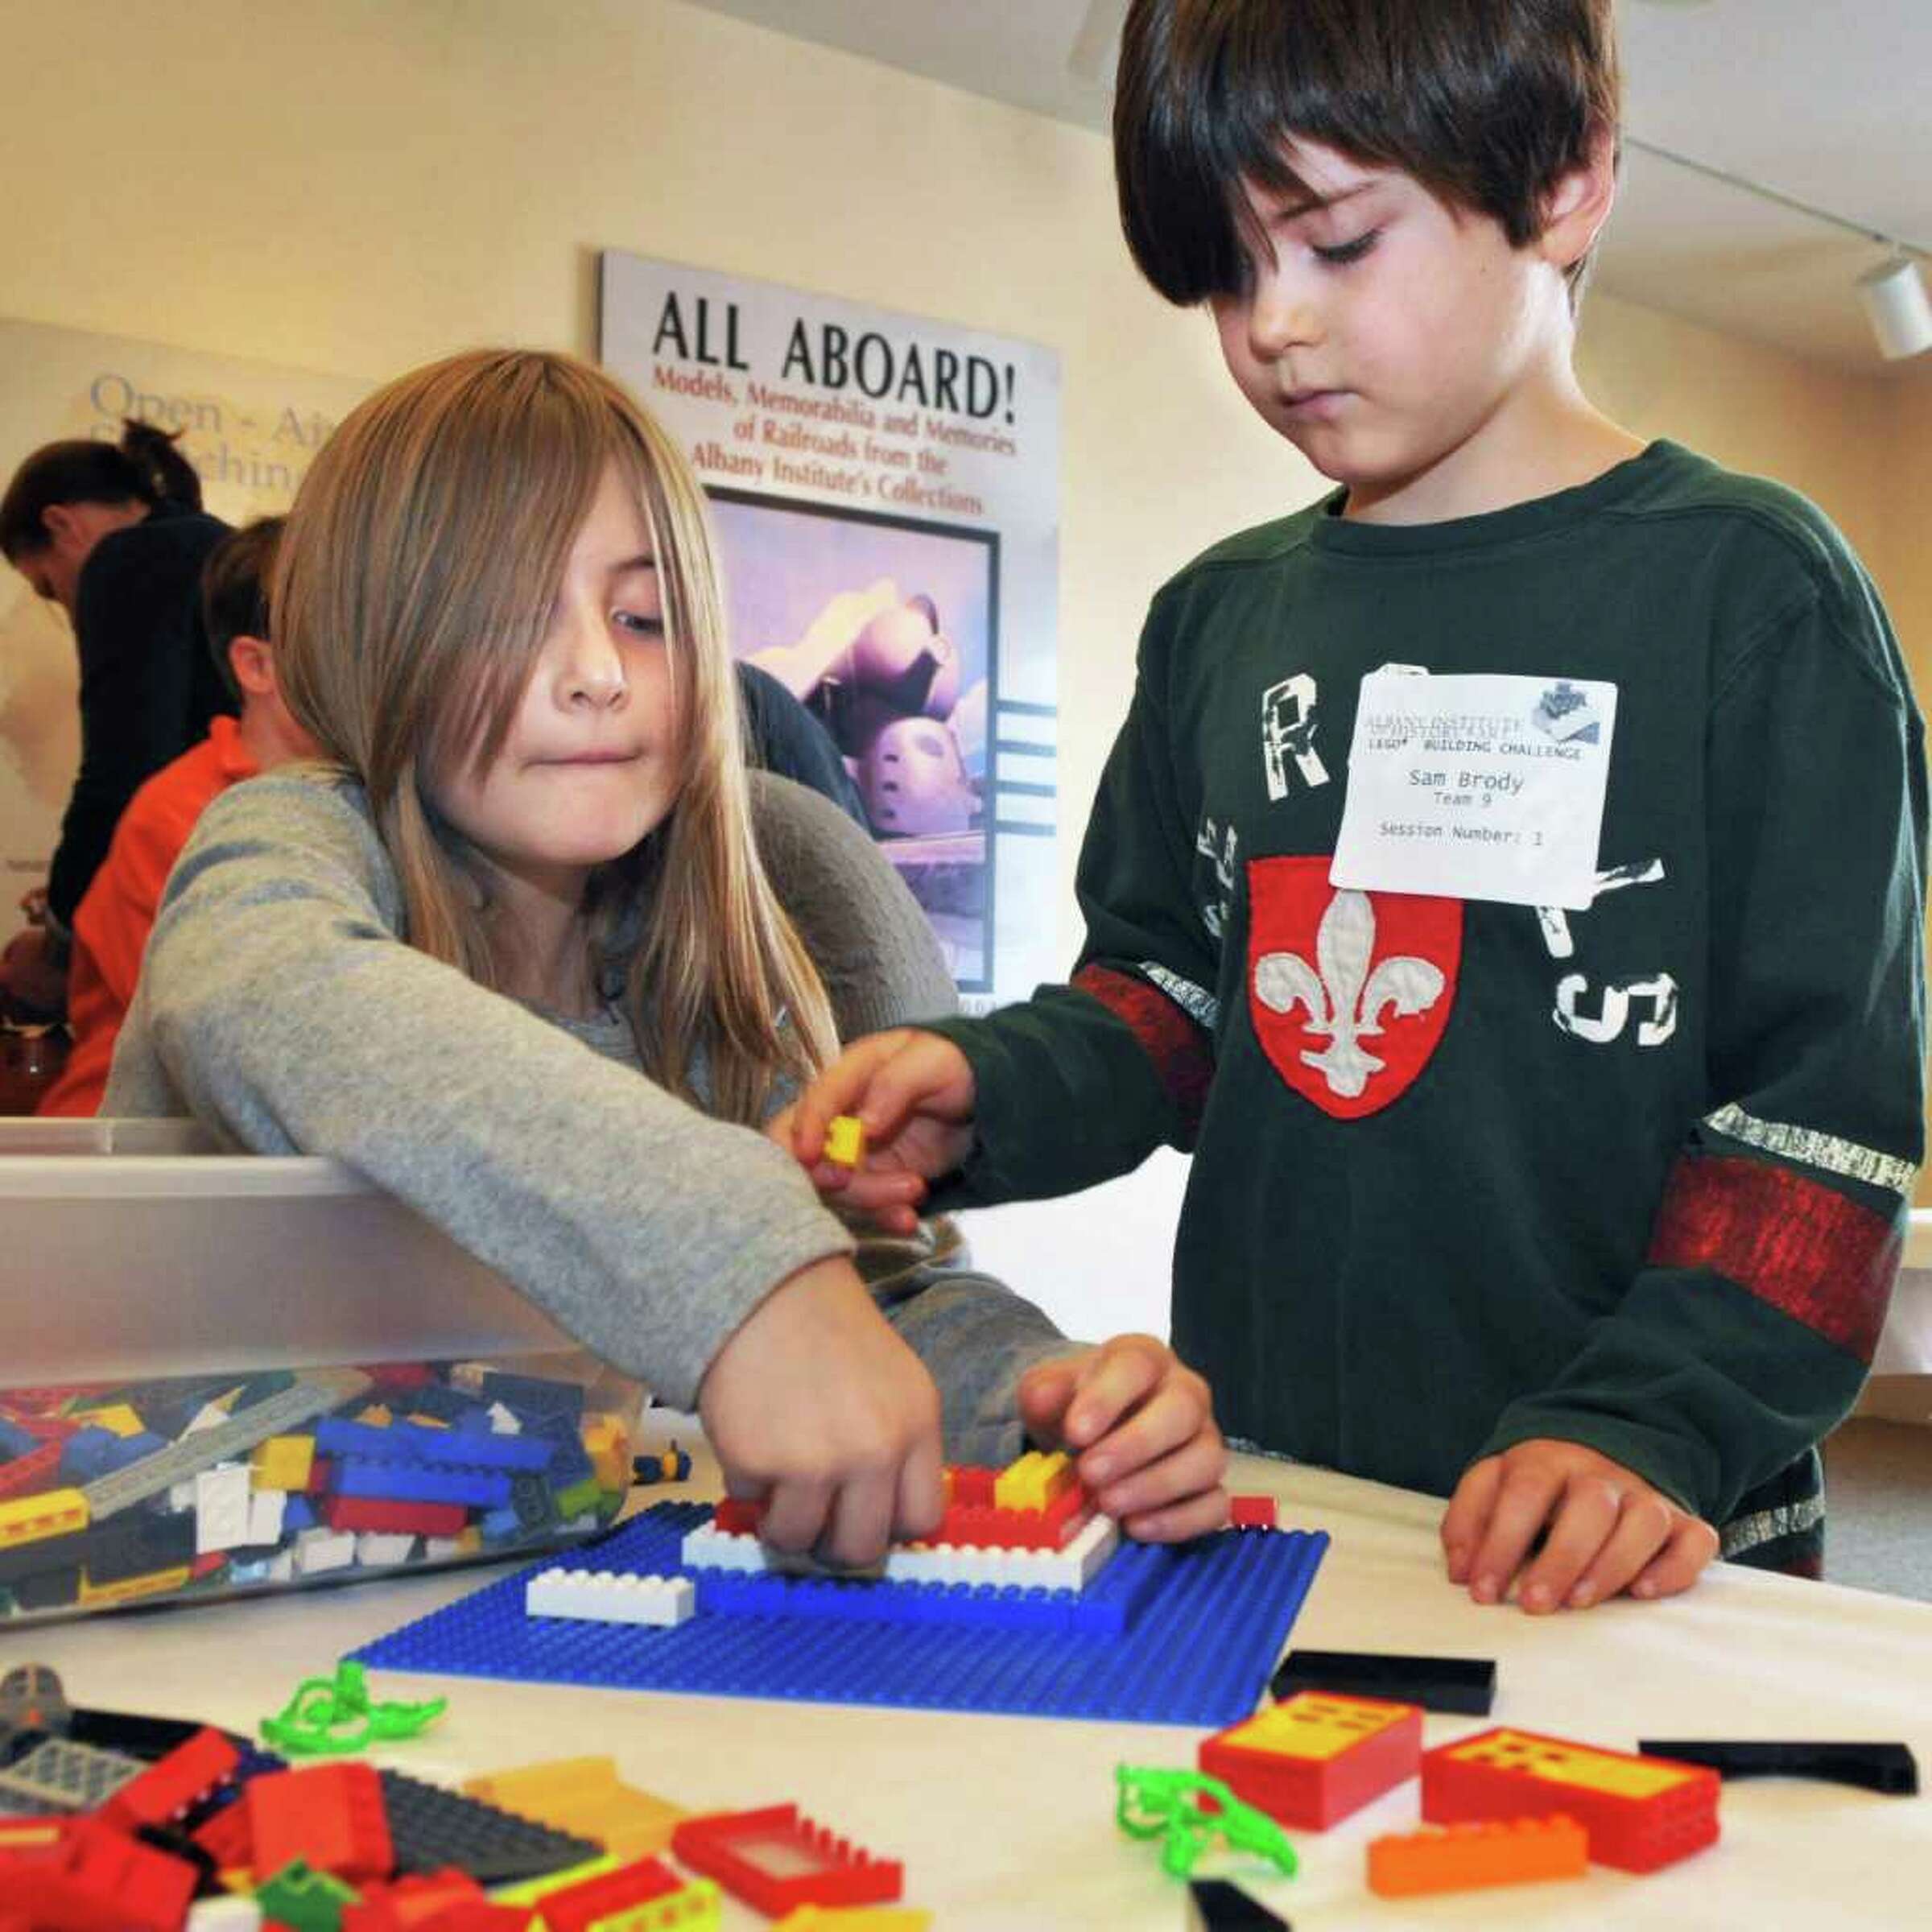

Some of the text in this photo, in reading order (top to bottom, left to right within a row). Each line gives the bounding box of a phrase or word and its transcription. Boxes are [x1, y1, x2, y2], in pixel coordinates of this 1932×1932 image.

[653, 291, 1016, 424] ALL ABOARD!
[89, 374, 221, 433] Open
[653, 365, 1018, 456] Models, Memorabilia and Memories
[733, 412, 948, 476] of Railroads from the
[691, 443, 984, 516] Albany Institute's Collections
[1422, 738, 1492, 753] BUILDING
[1499, 742, 1583, 761] CHALLENGE
[1409, 769, 1525, 795] Sam Brody
[1433, 791, 1492, 807] Team 9
[1380, 820, 1543, 846] Session Number: 1
